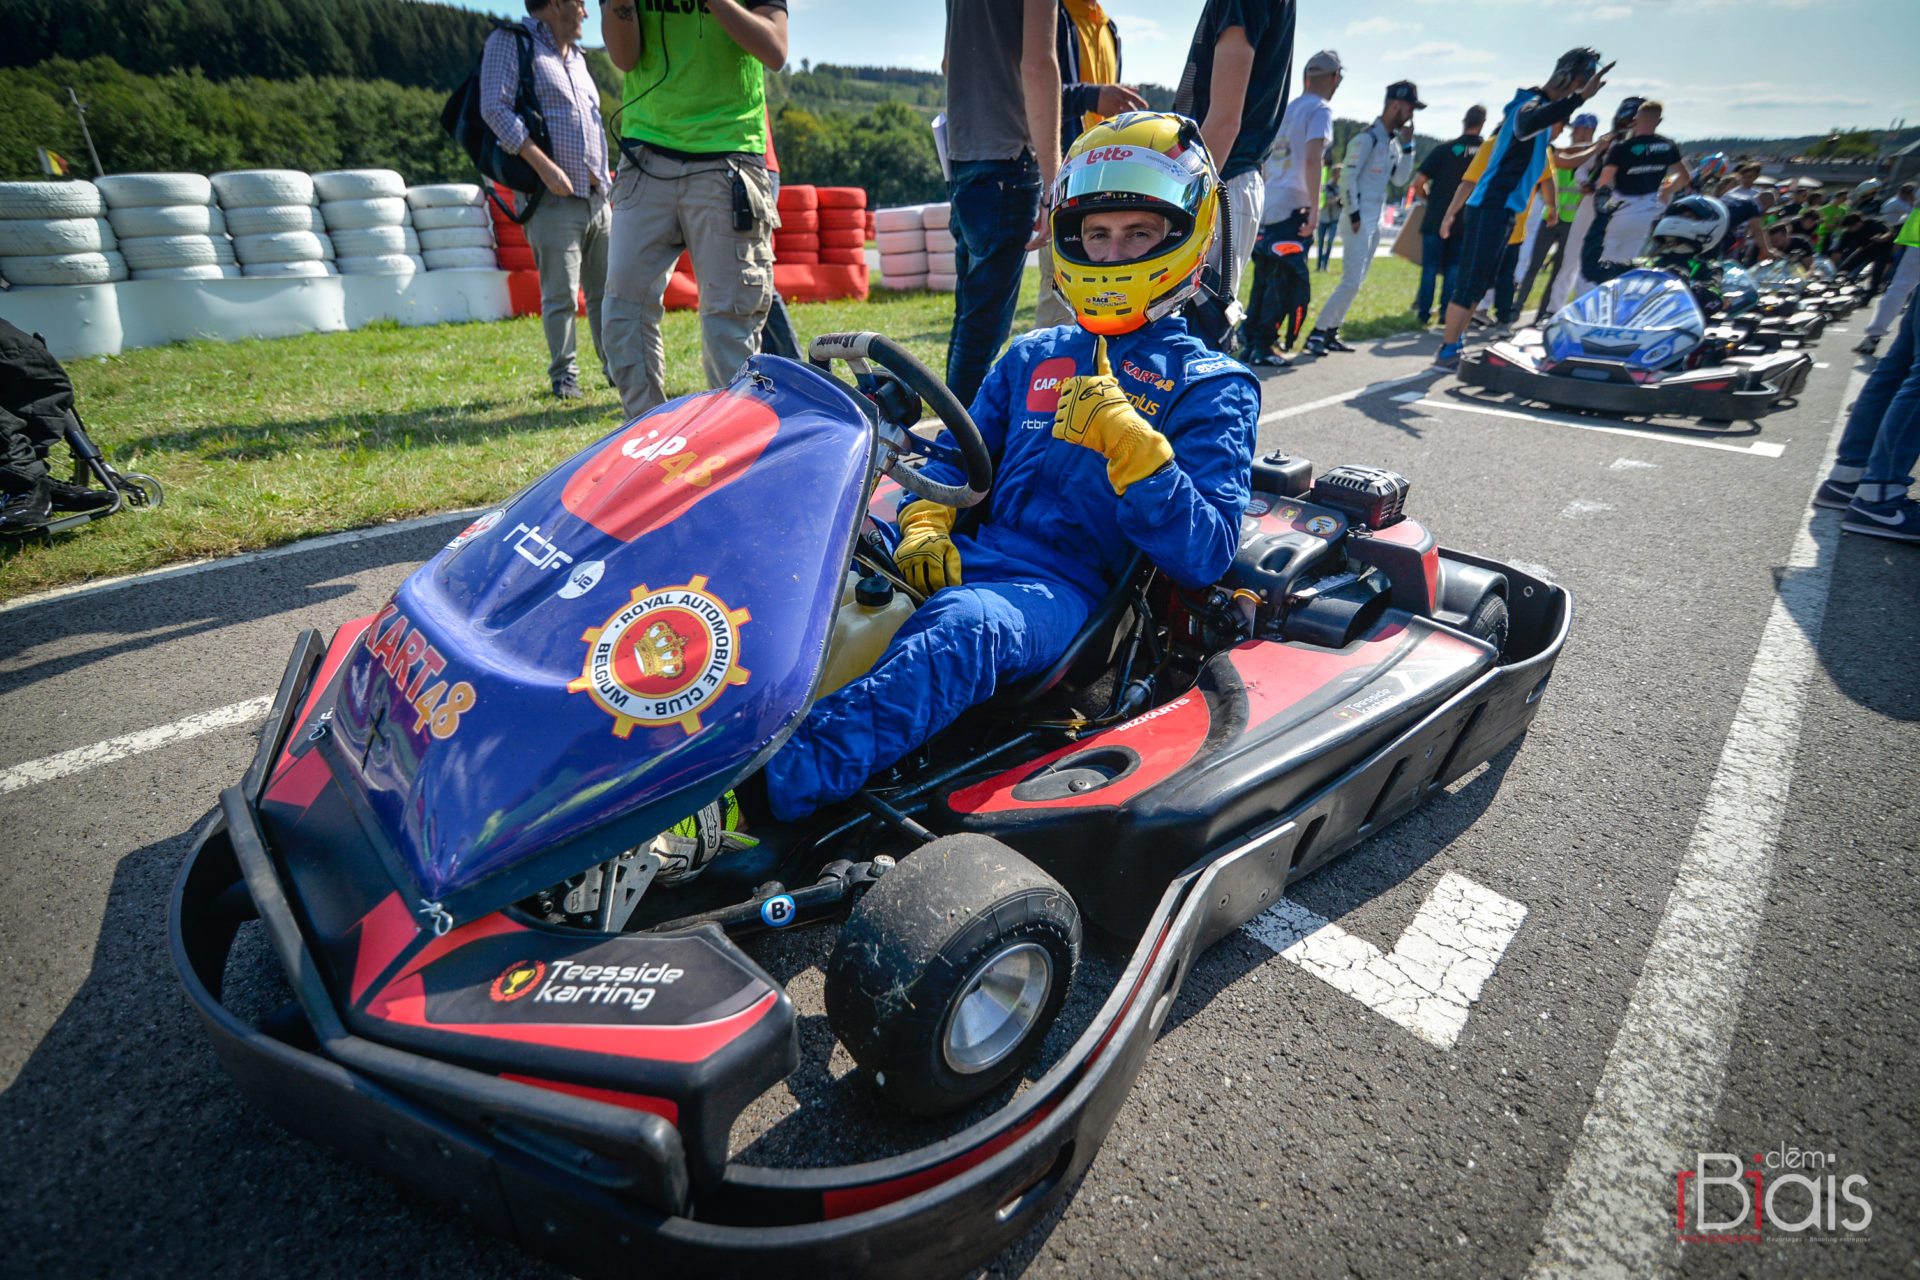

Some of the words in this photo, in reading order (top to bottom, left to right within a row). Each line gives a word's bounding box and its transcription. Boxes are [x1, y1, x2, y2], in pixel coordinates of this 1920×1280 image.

[1086, 146, 1134, 165] Lotto
[1121, 359, 1175, 392] KART48
[620, 593, 674, 625] ROYAL
[678, 593, 729, 687] AUTOMOBILE
[594, 642, 630, 708] BELGIUM
[655, 687, 704, 716] CLUB
[771, 901, 786, 920] B
[550, 960, 684, 984] Teesside
[533, 980, 657, 1011] karting
